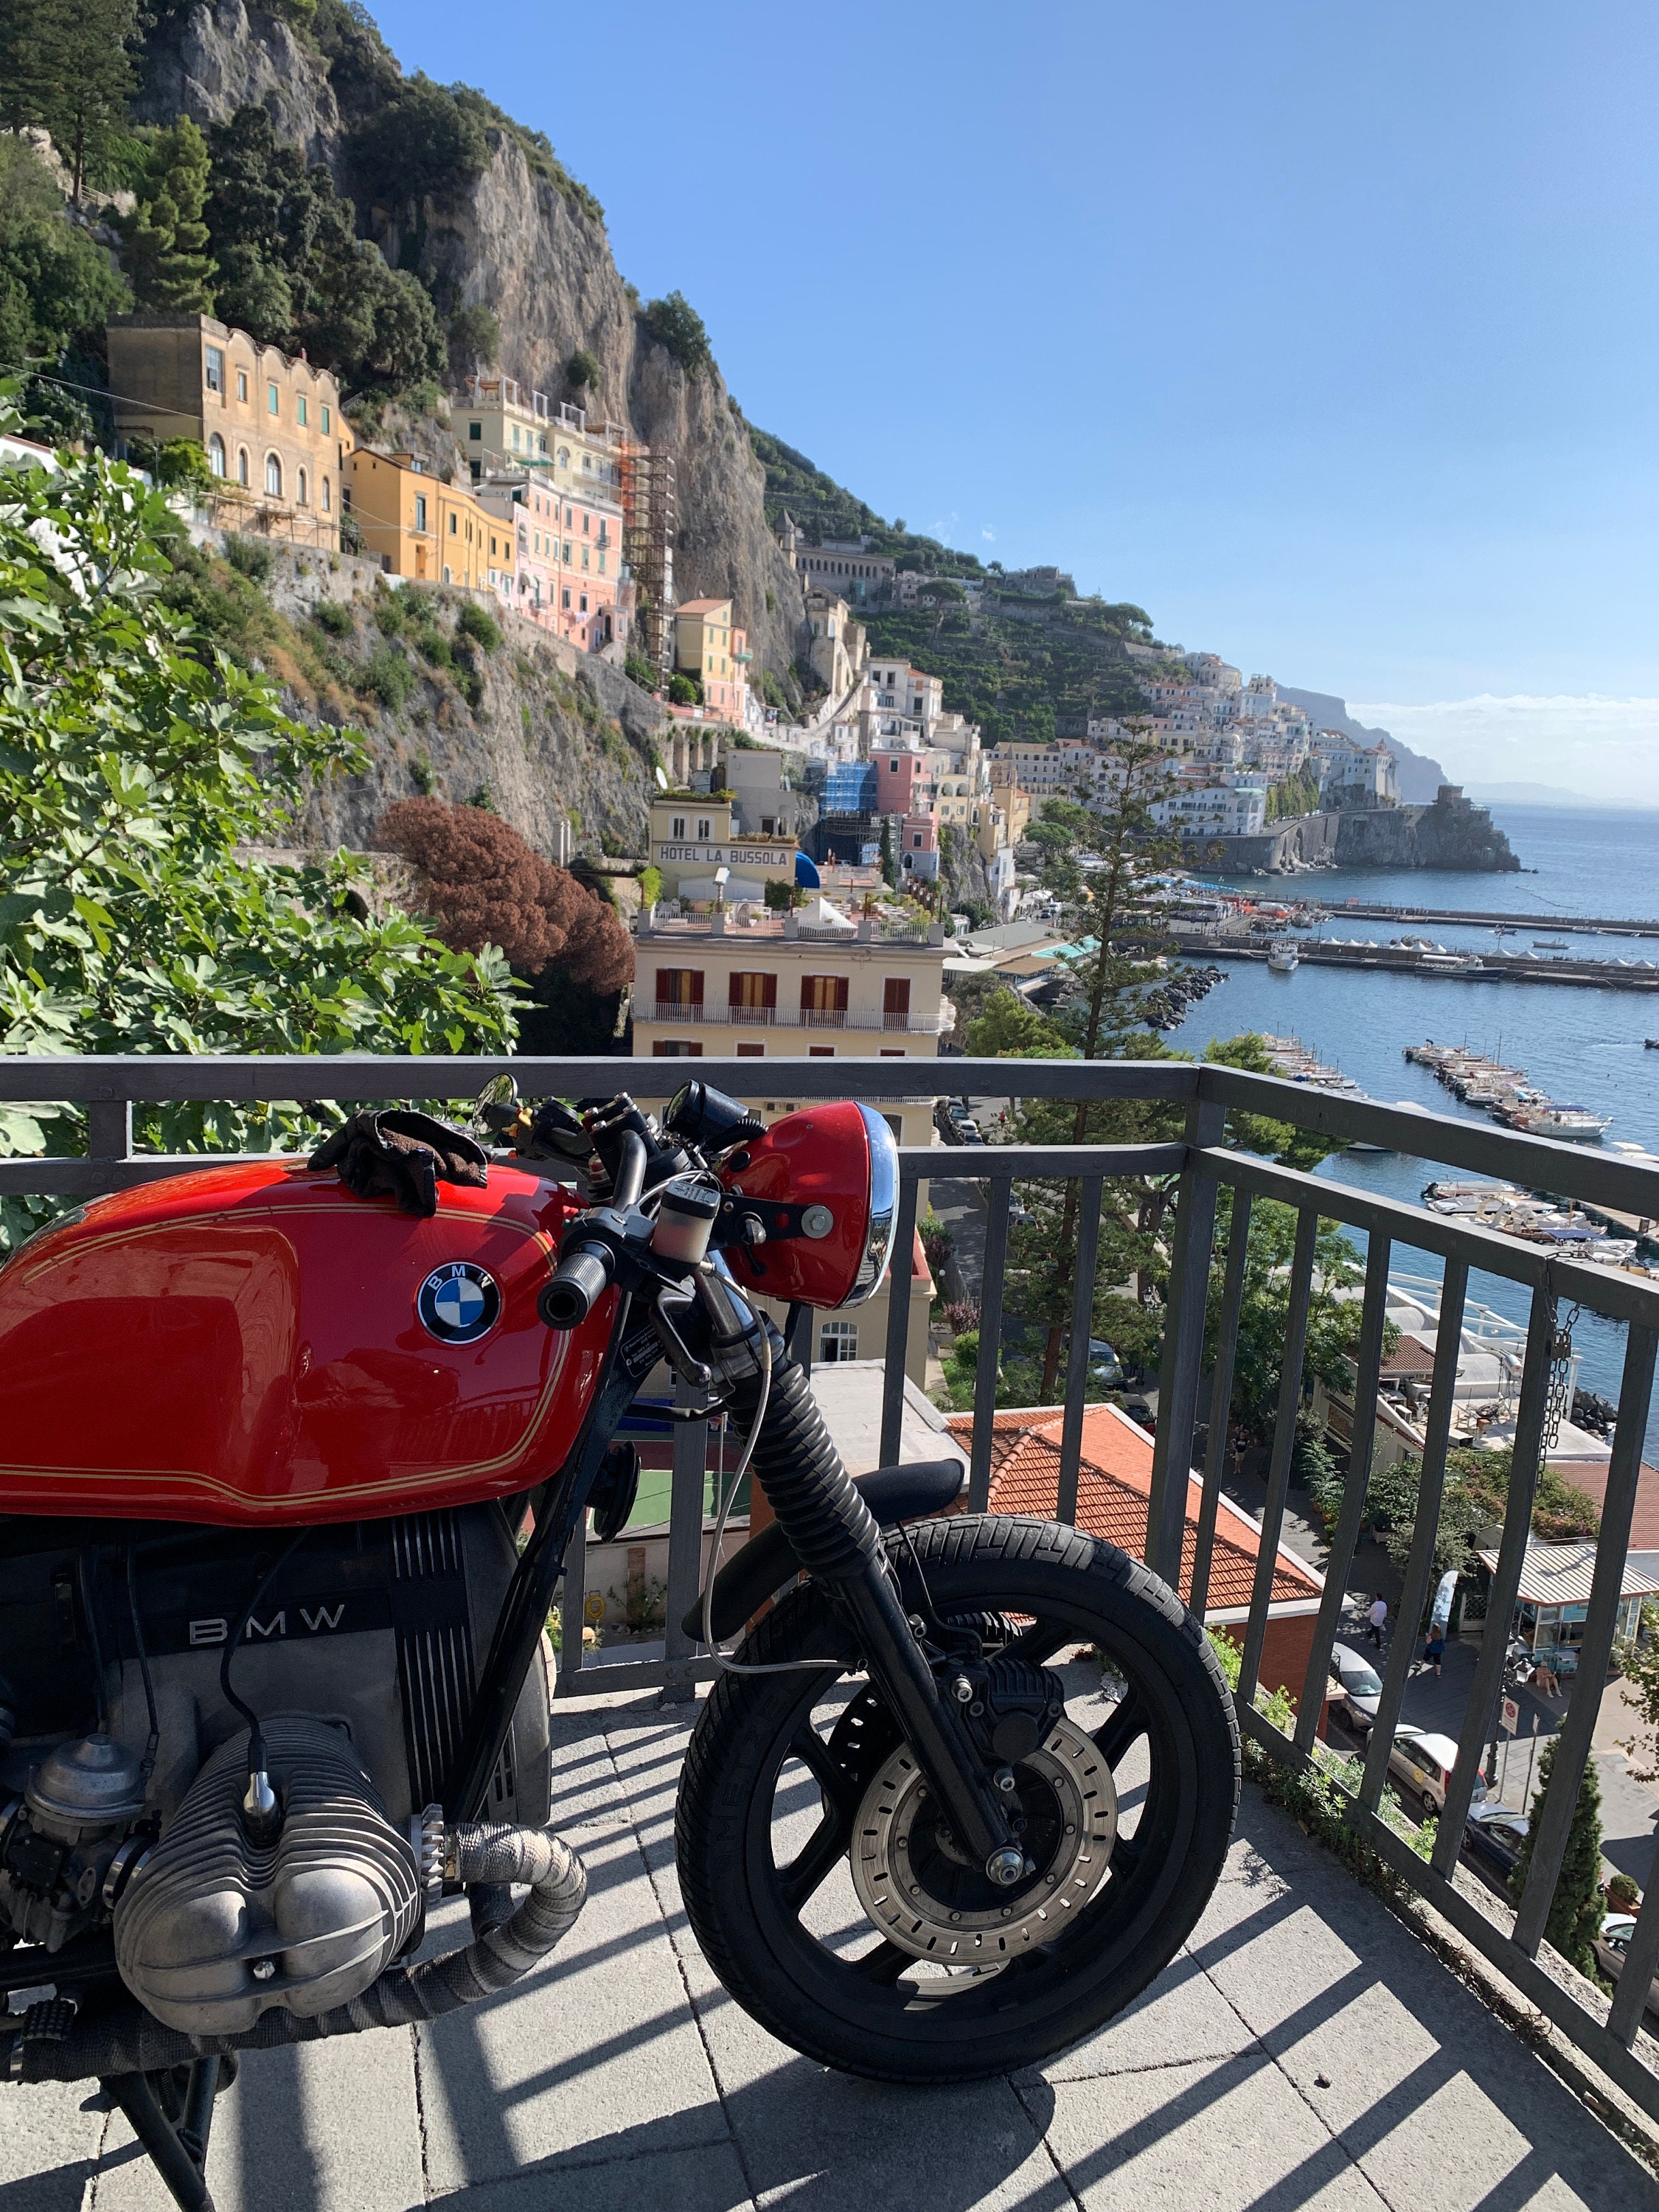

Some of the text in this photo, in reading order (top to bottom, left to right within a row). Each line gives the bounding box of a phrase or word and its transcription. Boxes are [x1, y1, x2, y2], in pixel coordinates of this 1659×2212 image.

[660, 846, 787, 866] HOTEL LA BUSSOLA
[428, 1265, 495, 1290] BMW
[189, 1604, 344, 1644] BMW
